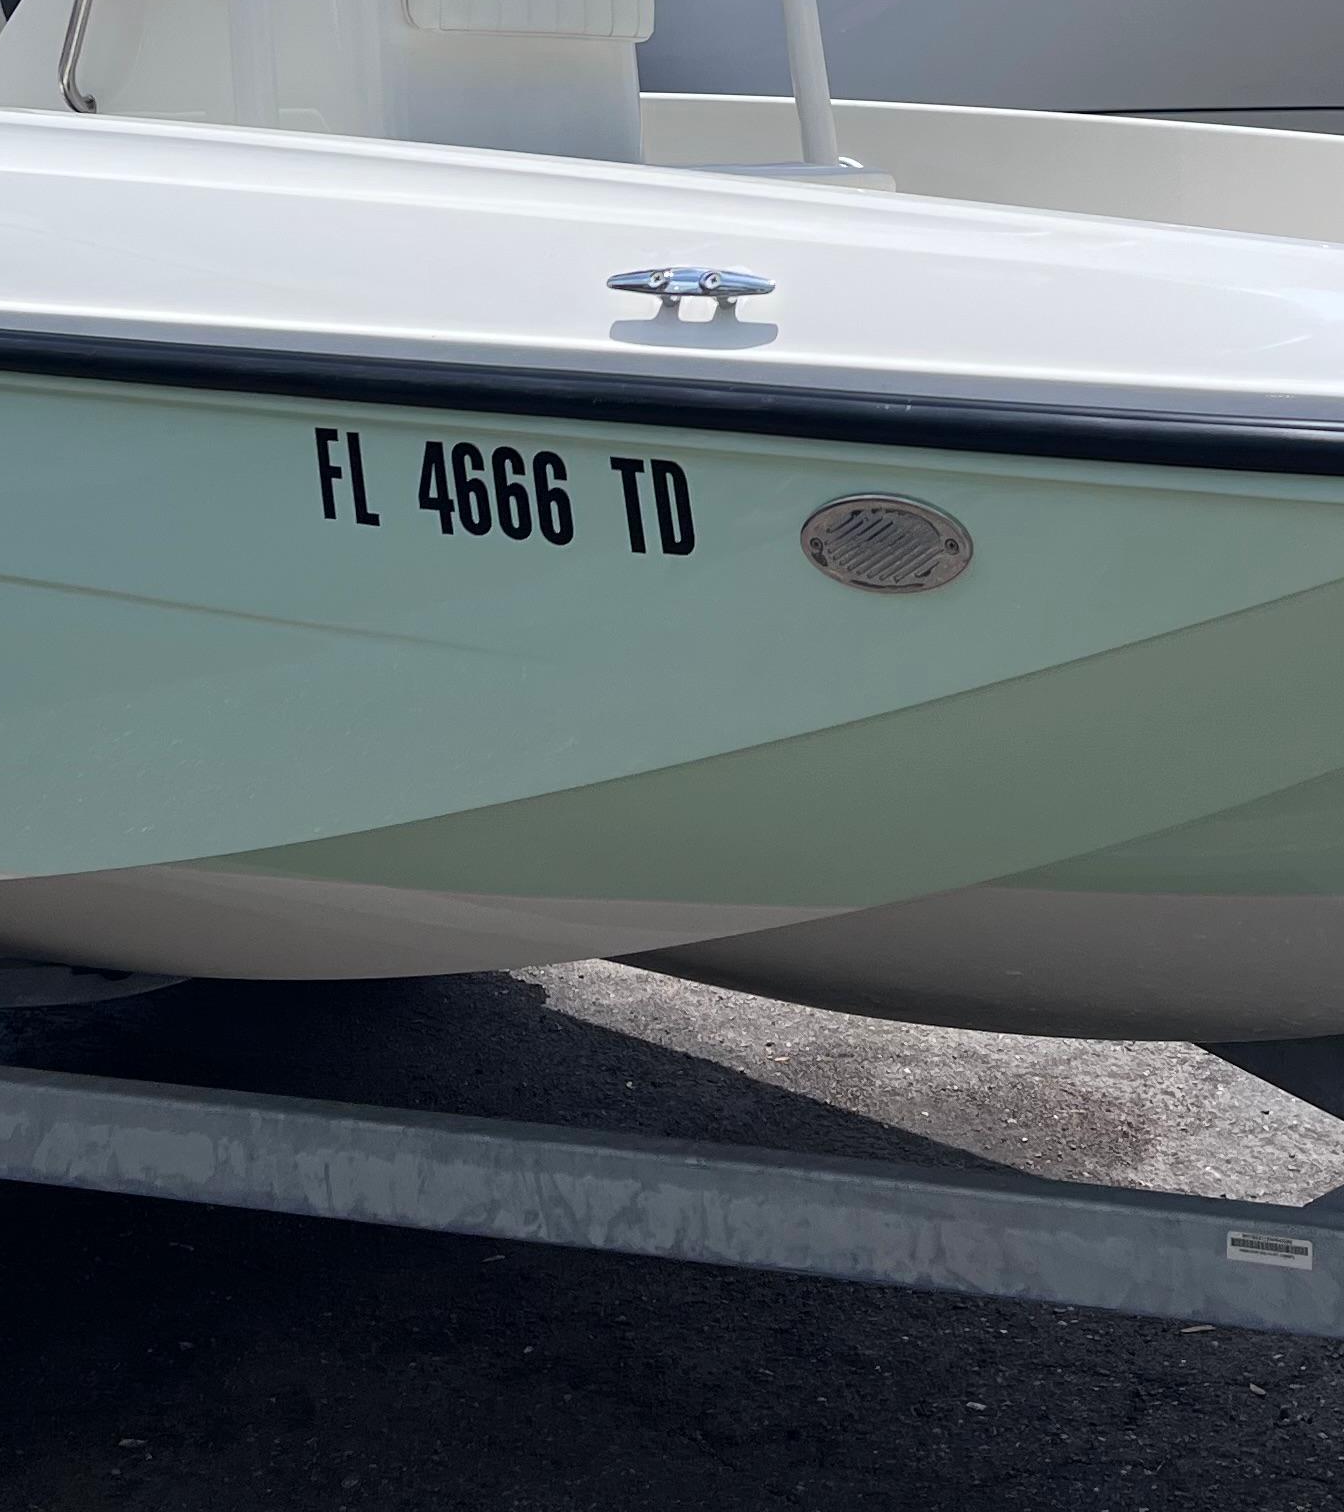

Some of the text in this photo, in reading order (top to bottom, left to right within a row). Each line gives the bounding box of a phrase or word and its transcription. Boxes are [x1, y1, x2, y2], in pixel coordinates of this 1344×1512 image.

[313, 426, 697, 557] FL 4666 TD
